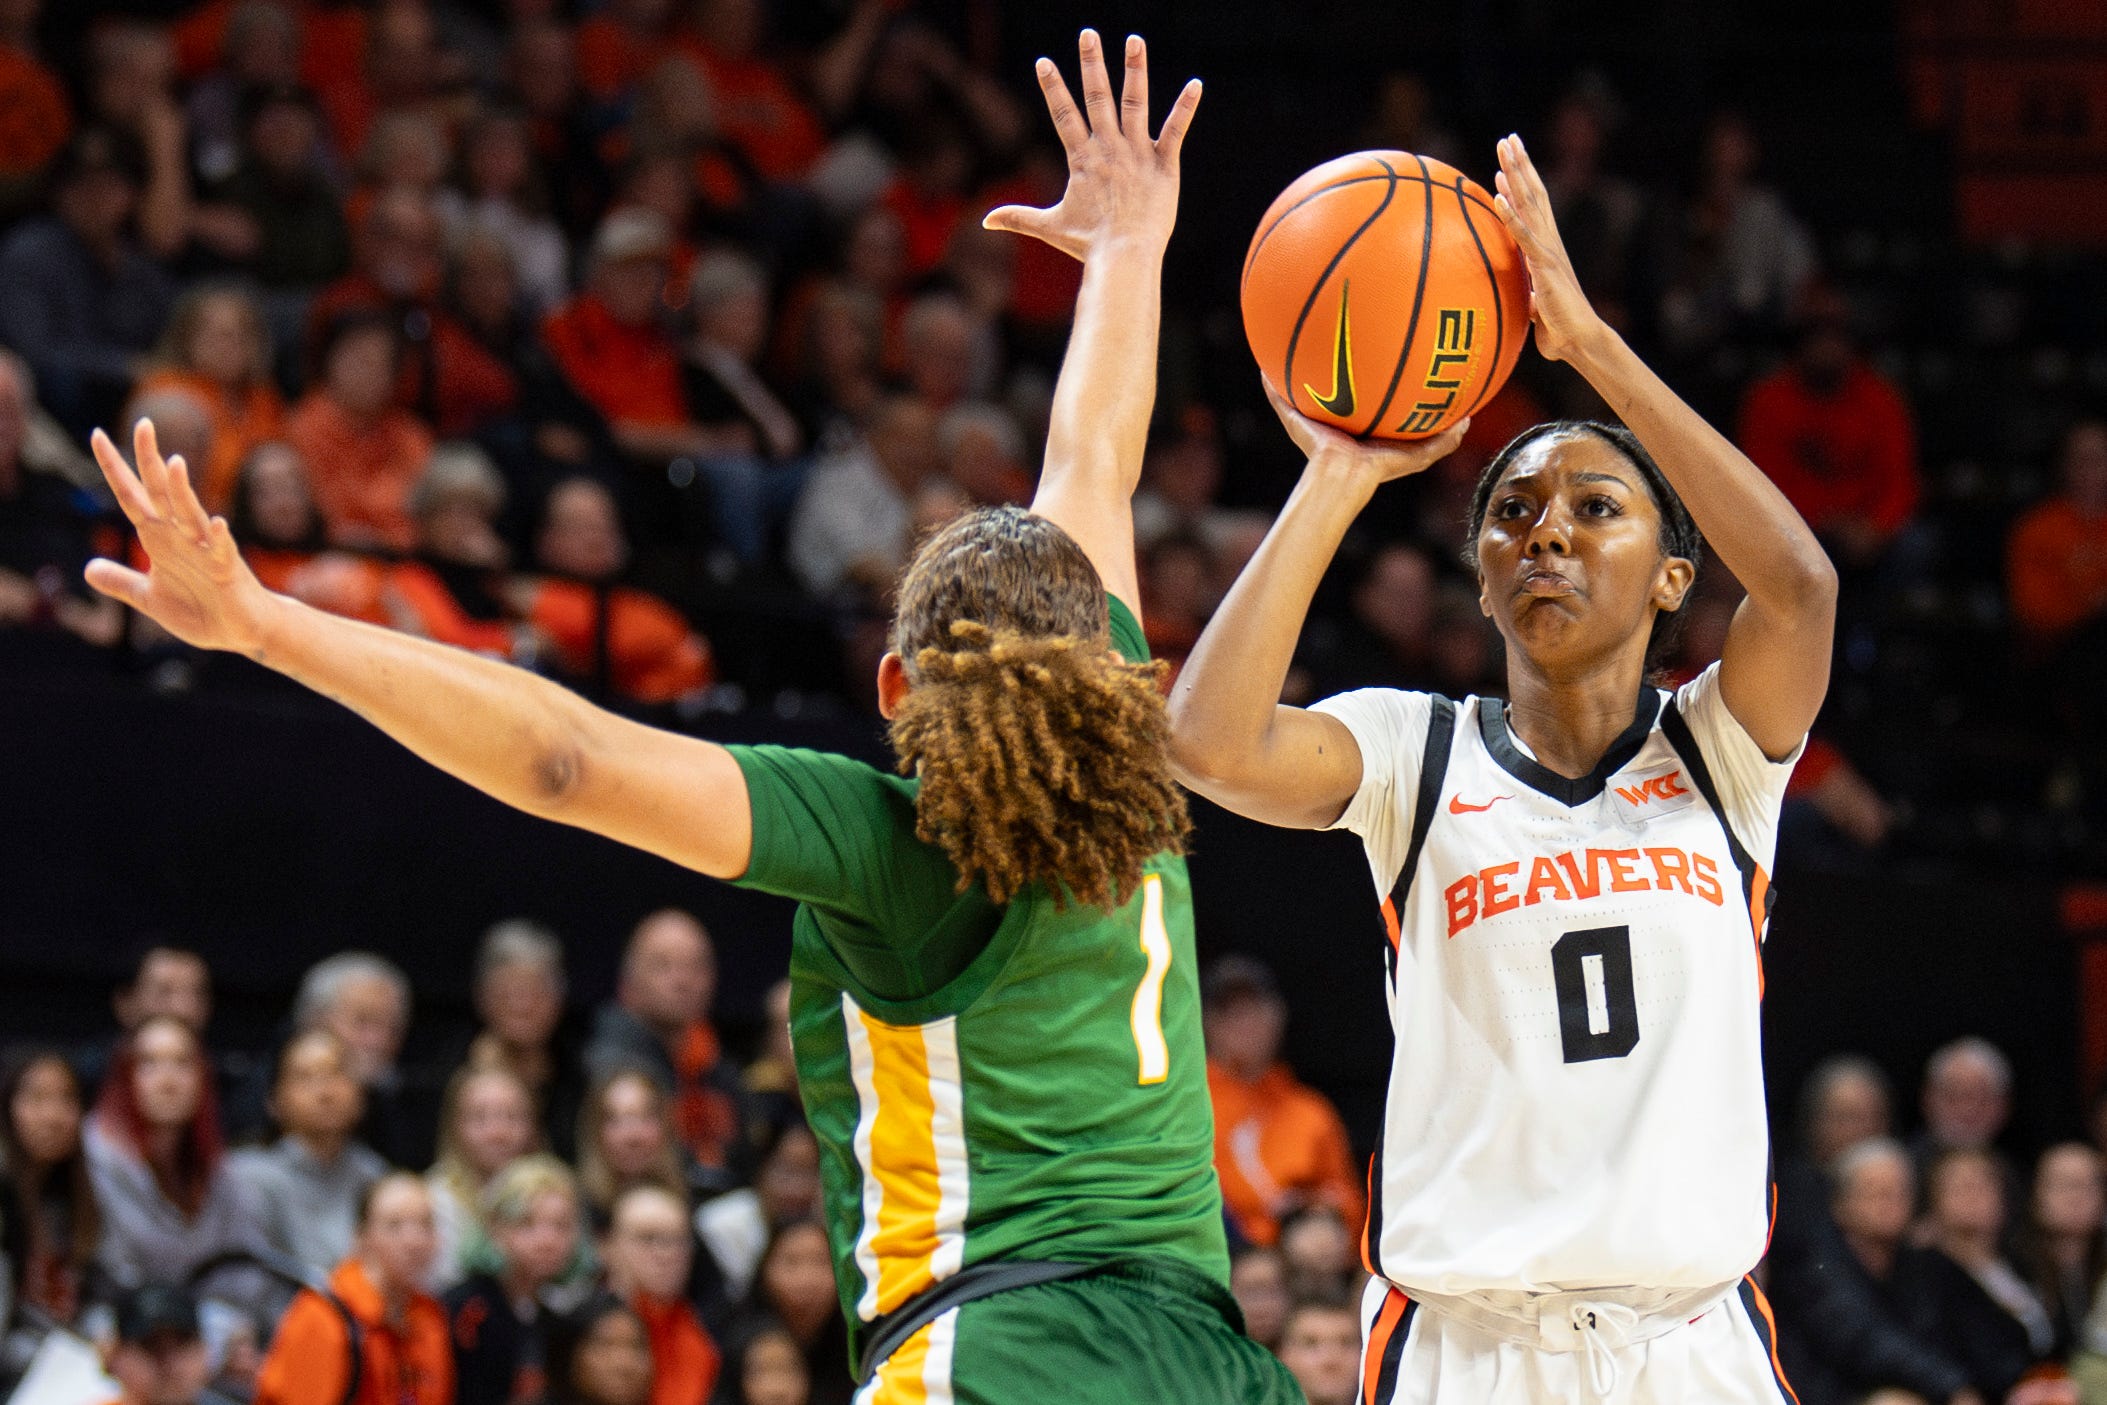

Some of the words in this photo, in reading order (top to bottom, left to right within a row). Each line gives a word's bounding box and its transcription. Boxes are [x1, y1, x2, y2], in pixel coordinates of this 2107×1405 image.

[1394, 307, 1475, 433] ELITE
[1614, 770, 1689, 808] WCC
[1444, 847, 1724, 940] BEAVERS
[1130, 873, 1173, 1085] 1
[1550, 925, 1641, 1064] 0
